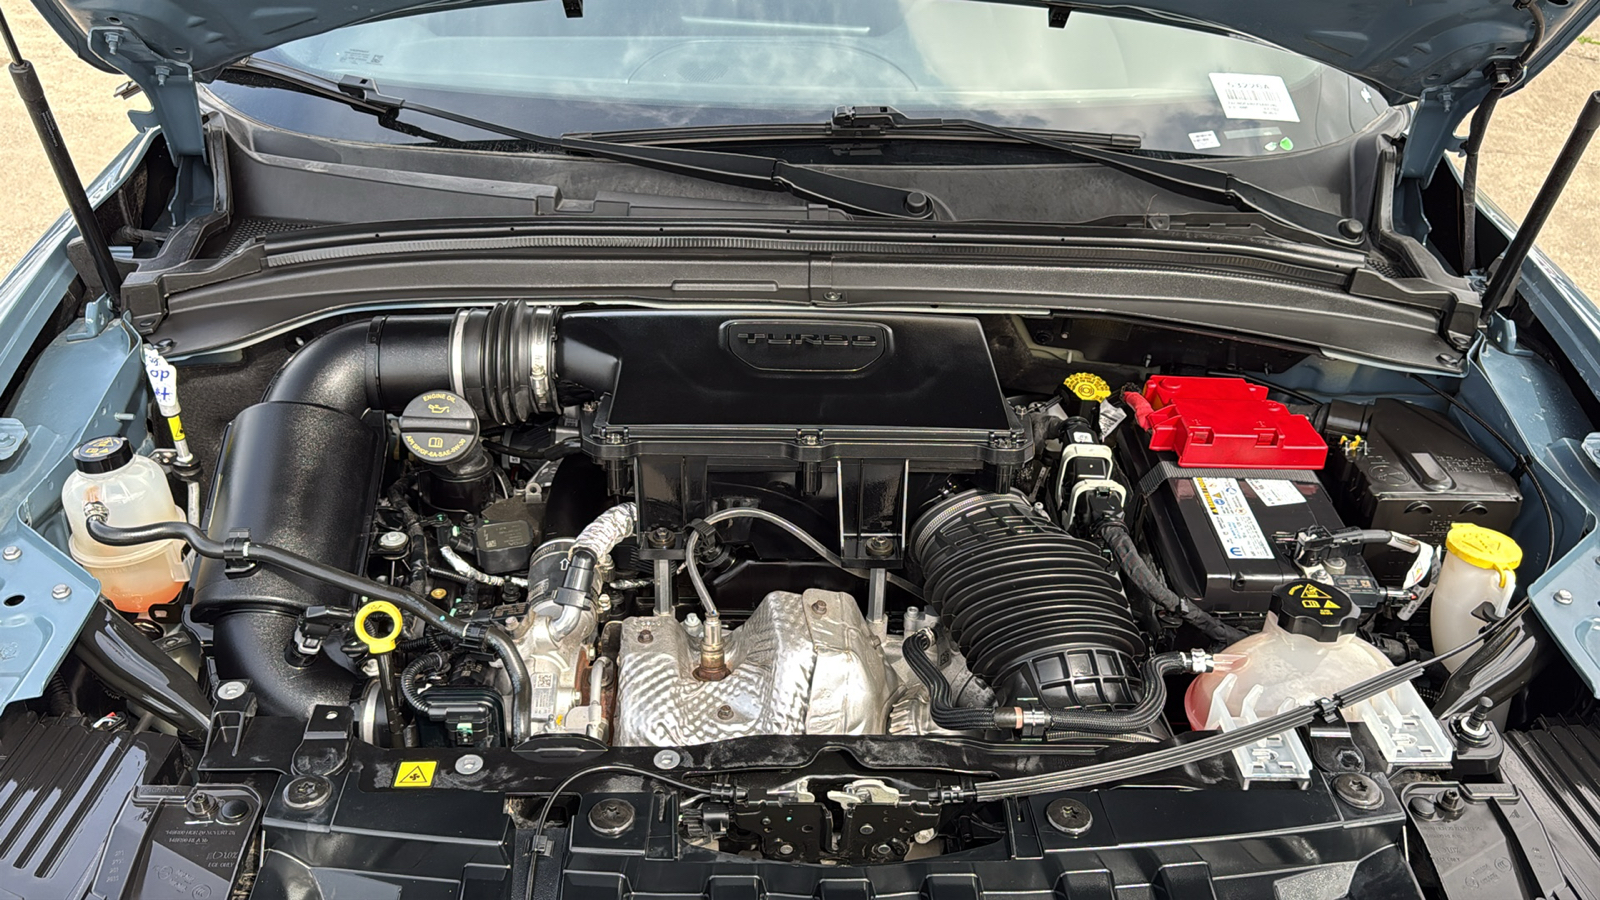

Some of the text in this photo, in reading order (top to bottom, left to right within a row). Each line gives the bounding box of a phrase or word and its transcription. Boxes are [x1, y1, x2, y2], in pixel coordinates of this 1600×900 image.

[737, 333, 877, 347] TURBO
[422, 393, 456, 404] ENGINE OIL
[405, 435, 415, 446] API
